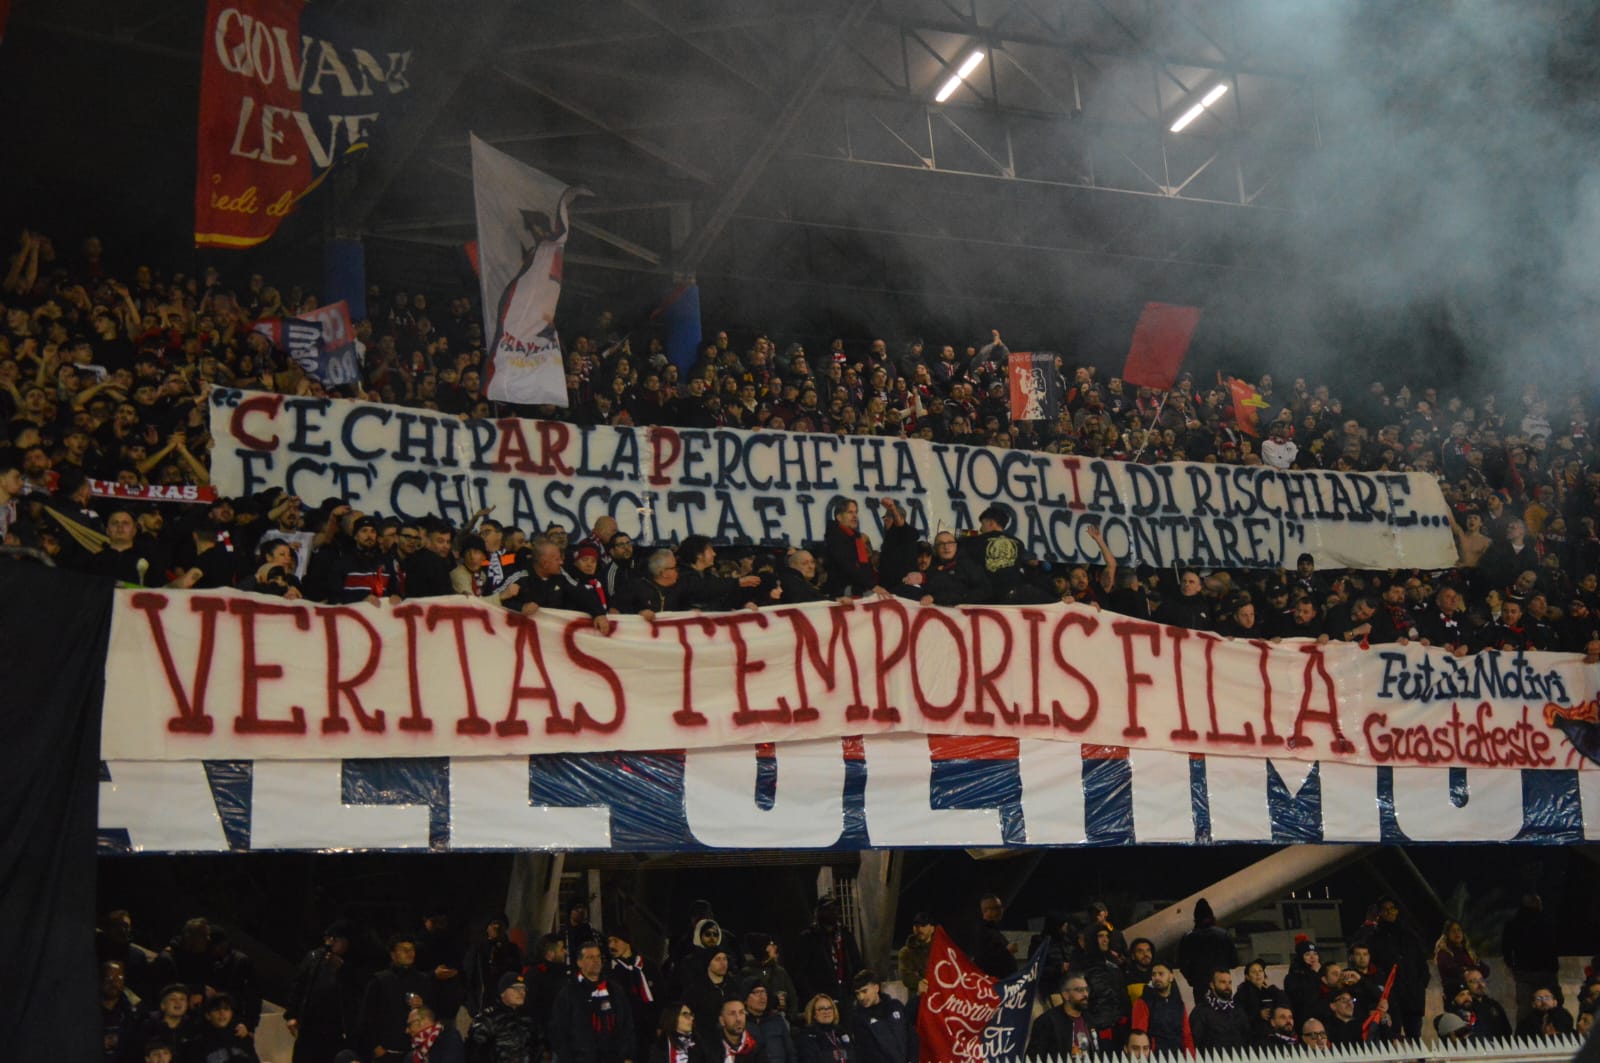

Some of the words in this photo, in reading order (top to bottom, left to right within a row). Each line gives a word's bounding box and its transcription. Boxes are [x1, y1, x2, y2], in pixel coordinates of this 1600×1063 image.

[341, 405, 459, 467] CHI
[465, 416, 642, 481] PARLA
[851, 437, 927, 495] HA
[932, 444, 1125, 514] VOGLIA
[1125, 463, 1184, 518] DI
[1185, 465, 1450, 528] RISCHIARE...
[508, 478, 754, 546] ASCOLTA
[753, 495, 791, 547] E
[130, 593, 626, 738] VERITAS
[651, 599, 1099, 734] TEMPORIS
[1111, 621, 1356, 753] FILIA
[1469, 648, 1570, 702] Motivi
[1362, 702, 1556, 767] Guastafeste
